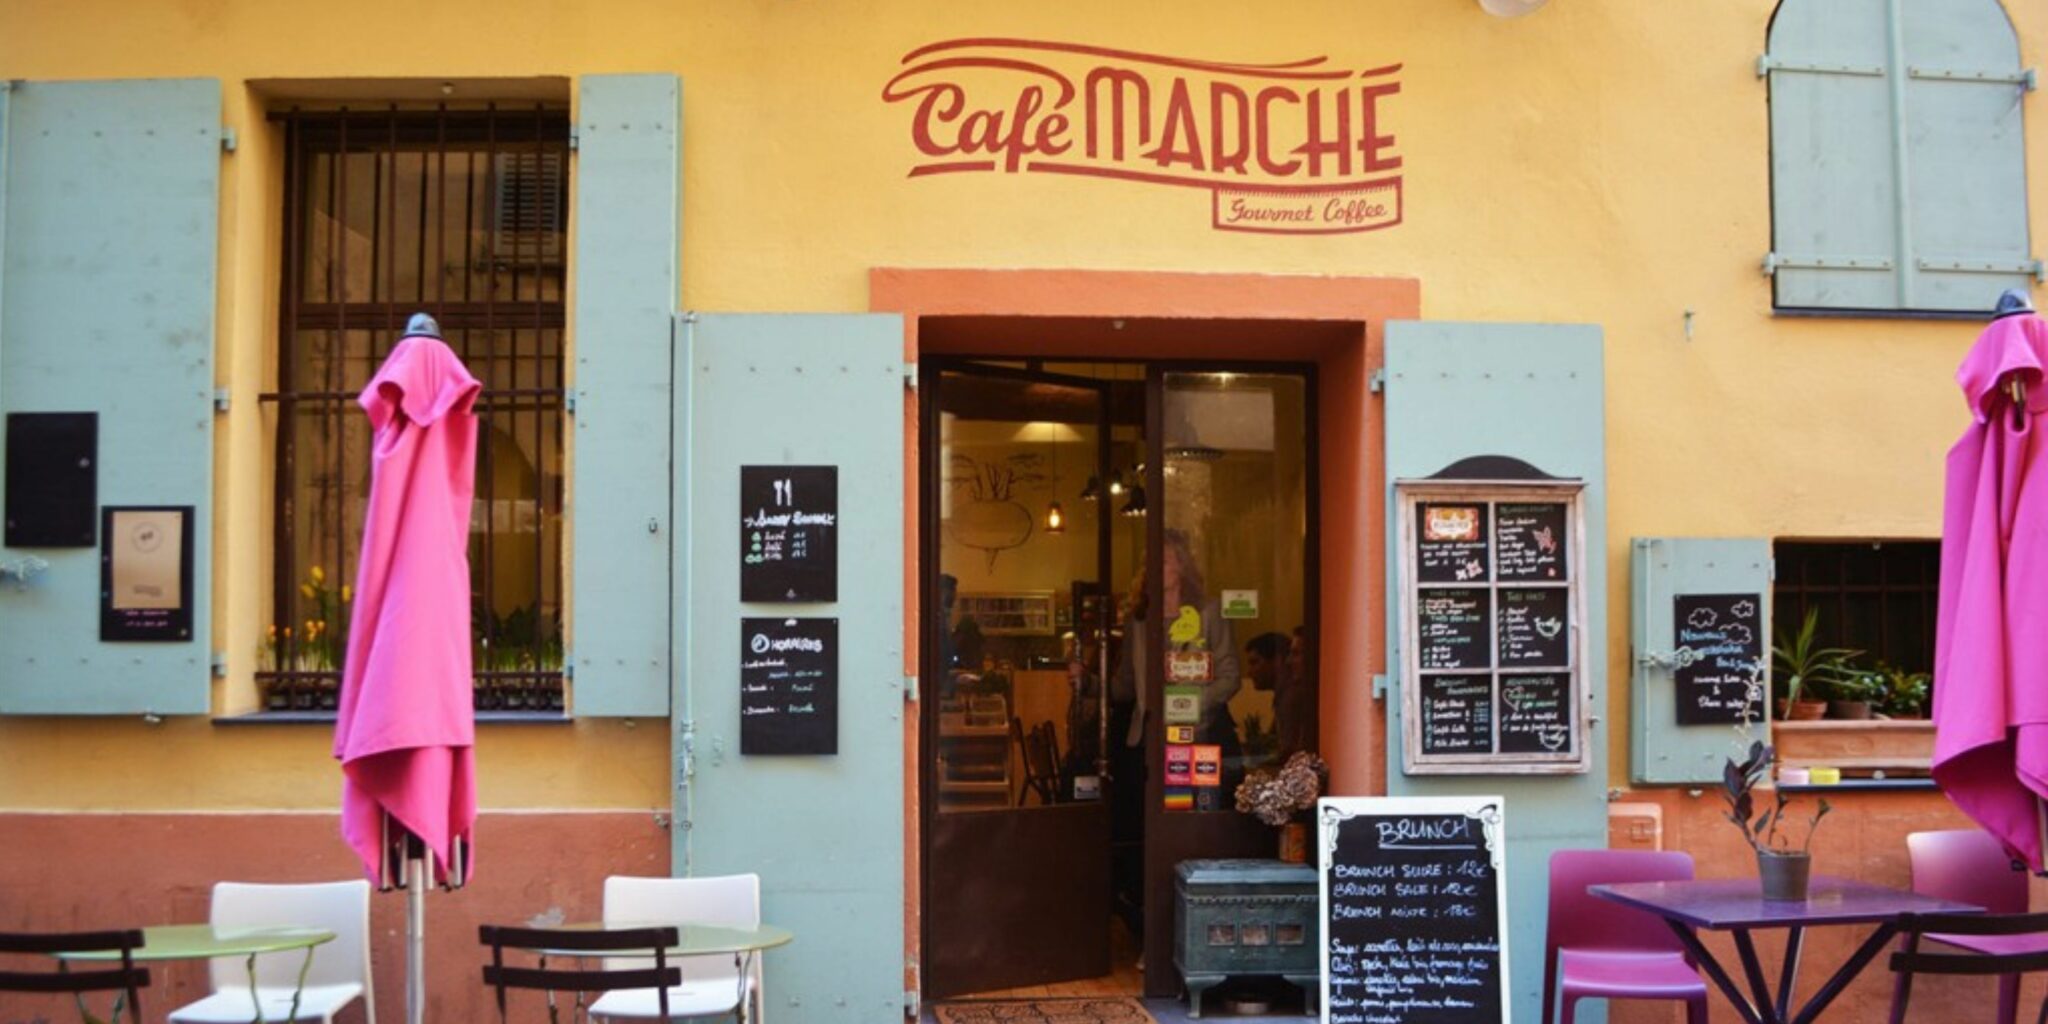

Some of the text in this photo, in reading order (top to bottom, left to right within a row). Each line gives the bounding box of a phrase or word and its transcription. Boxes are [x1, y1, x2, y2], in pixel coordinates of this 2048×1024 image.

[910, 64, 1402, 177] Café MARCHÉ
[1227, 199, 1387, 224] Gourmet Coffee
[1376, 817, 1469, 844] BRUNCH
[1335, 863, 1395, 878] BRUNCH
[1333, 883, 1386, 897] BRUNCH
[1332, 903, 1382, 920] BRUNCH
